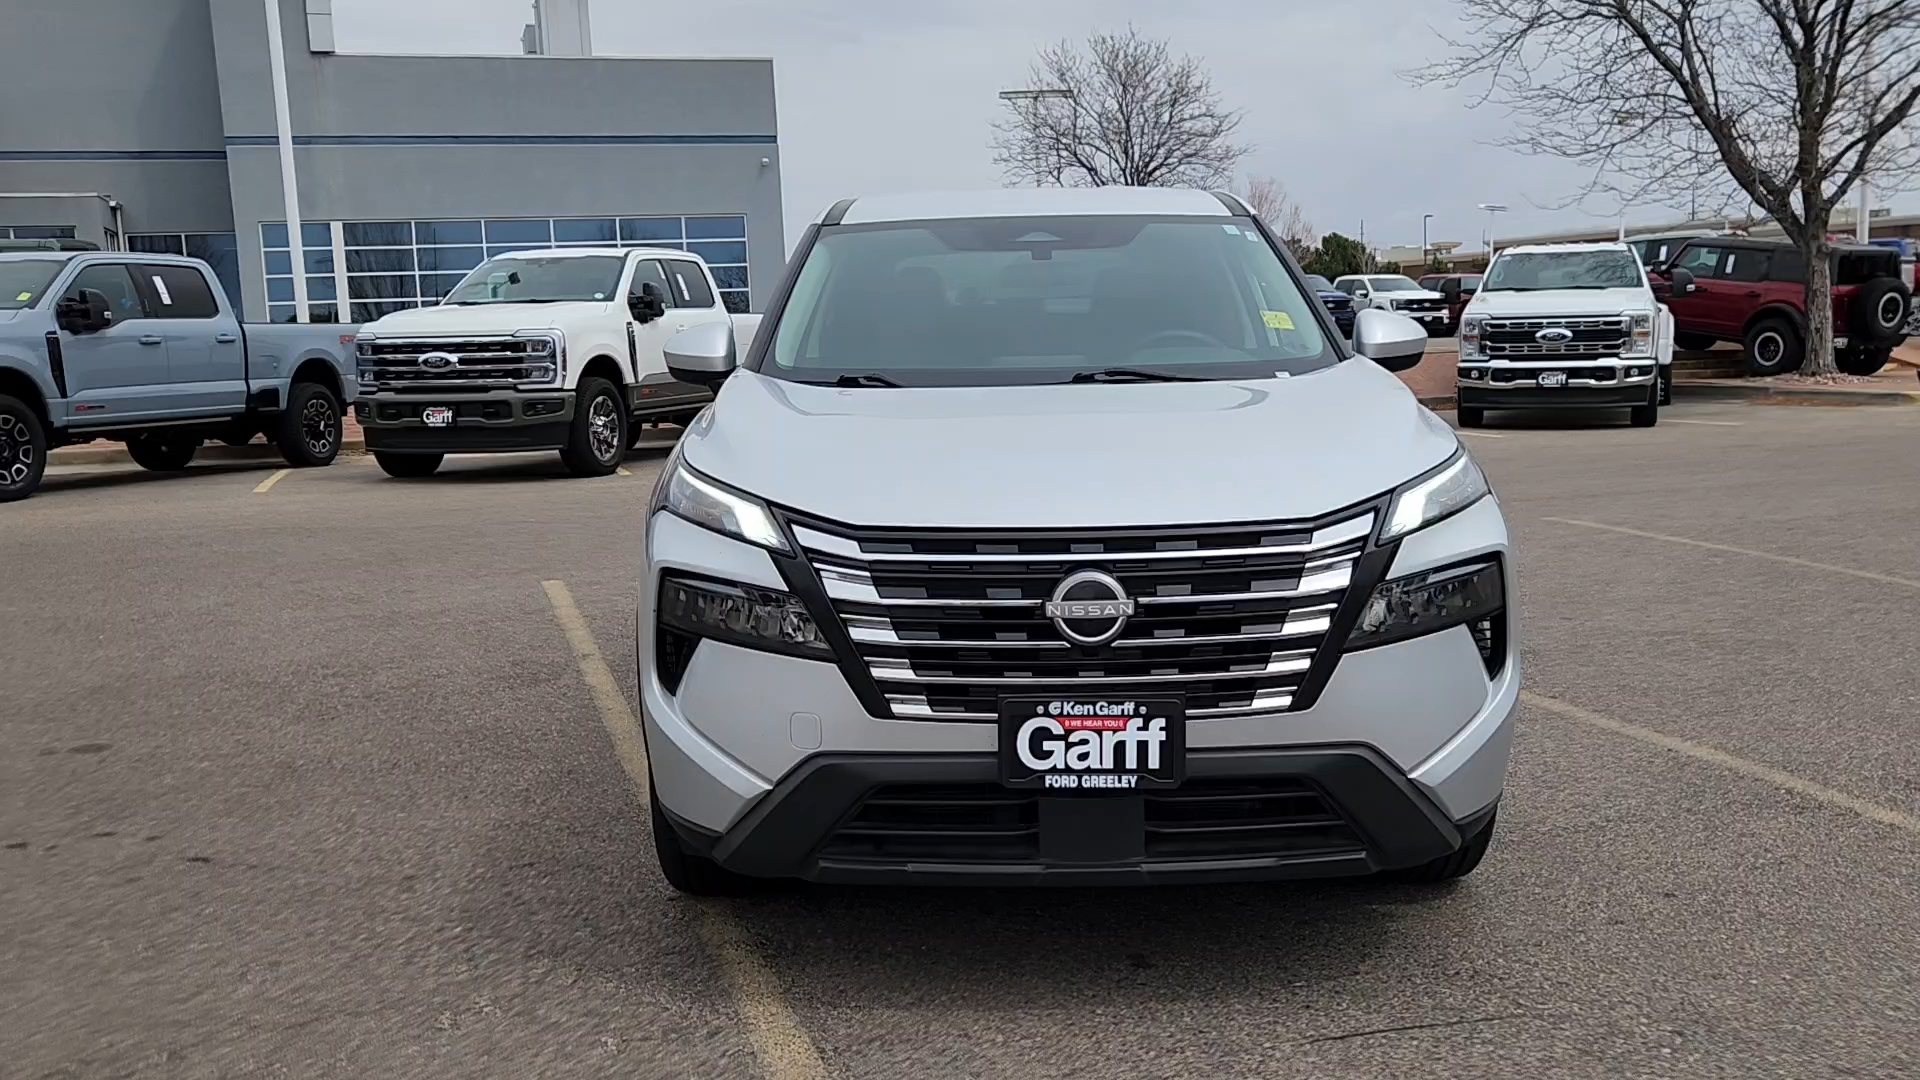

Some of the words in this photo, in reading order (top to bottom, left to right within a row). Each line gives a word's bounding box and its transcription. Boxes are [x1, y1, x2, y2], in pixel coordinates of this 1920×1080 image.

[423, 410, 452, 423] Garff
[1048, 603, 1133, 616] NISSAN
[1063, 702, 1094, 715] Ken
[1096, 702, 1135, 715] Garff
[1016, 717, 1166, 770] Garff
[1045, 776, 1078, 788] FORD
[1082, 776, 1137, 788] GREELEY
